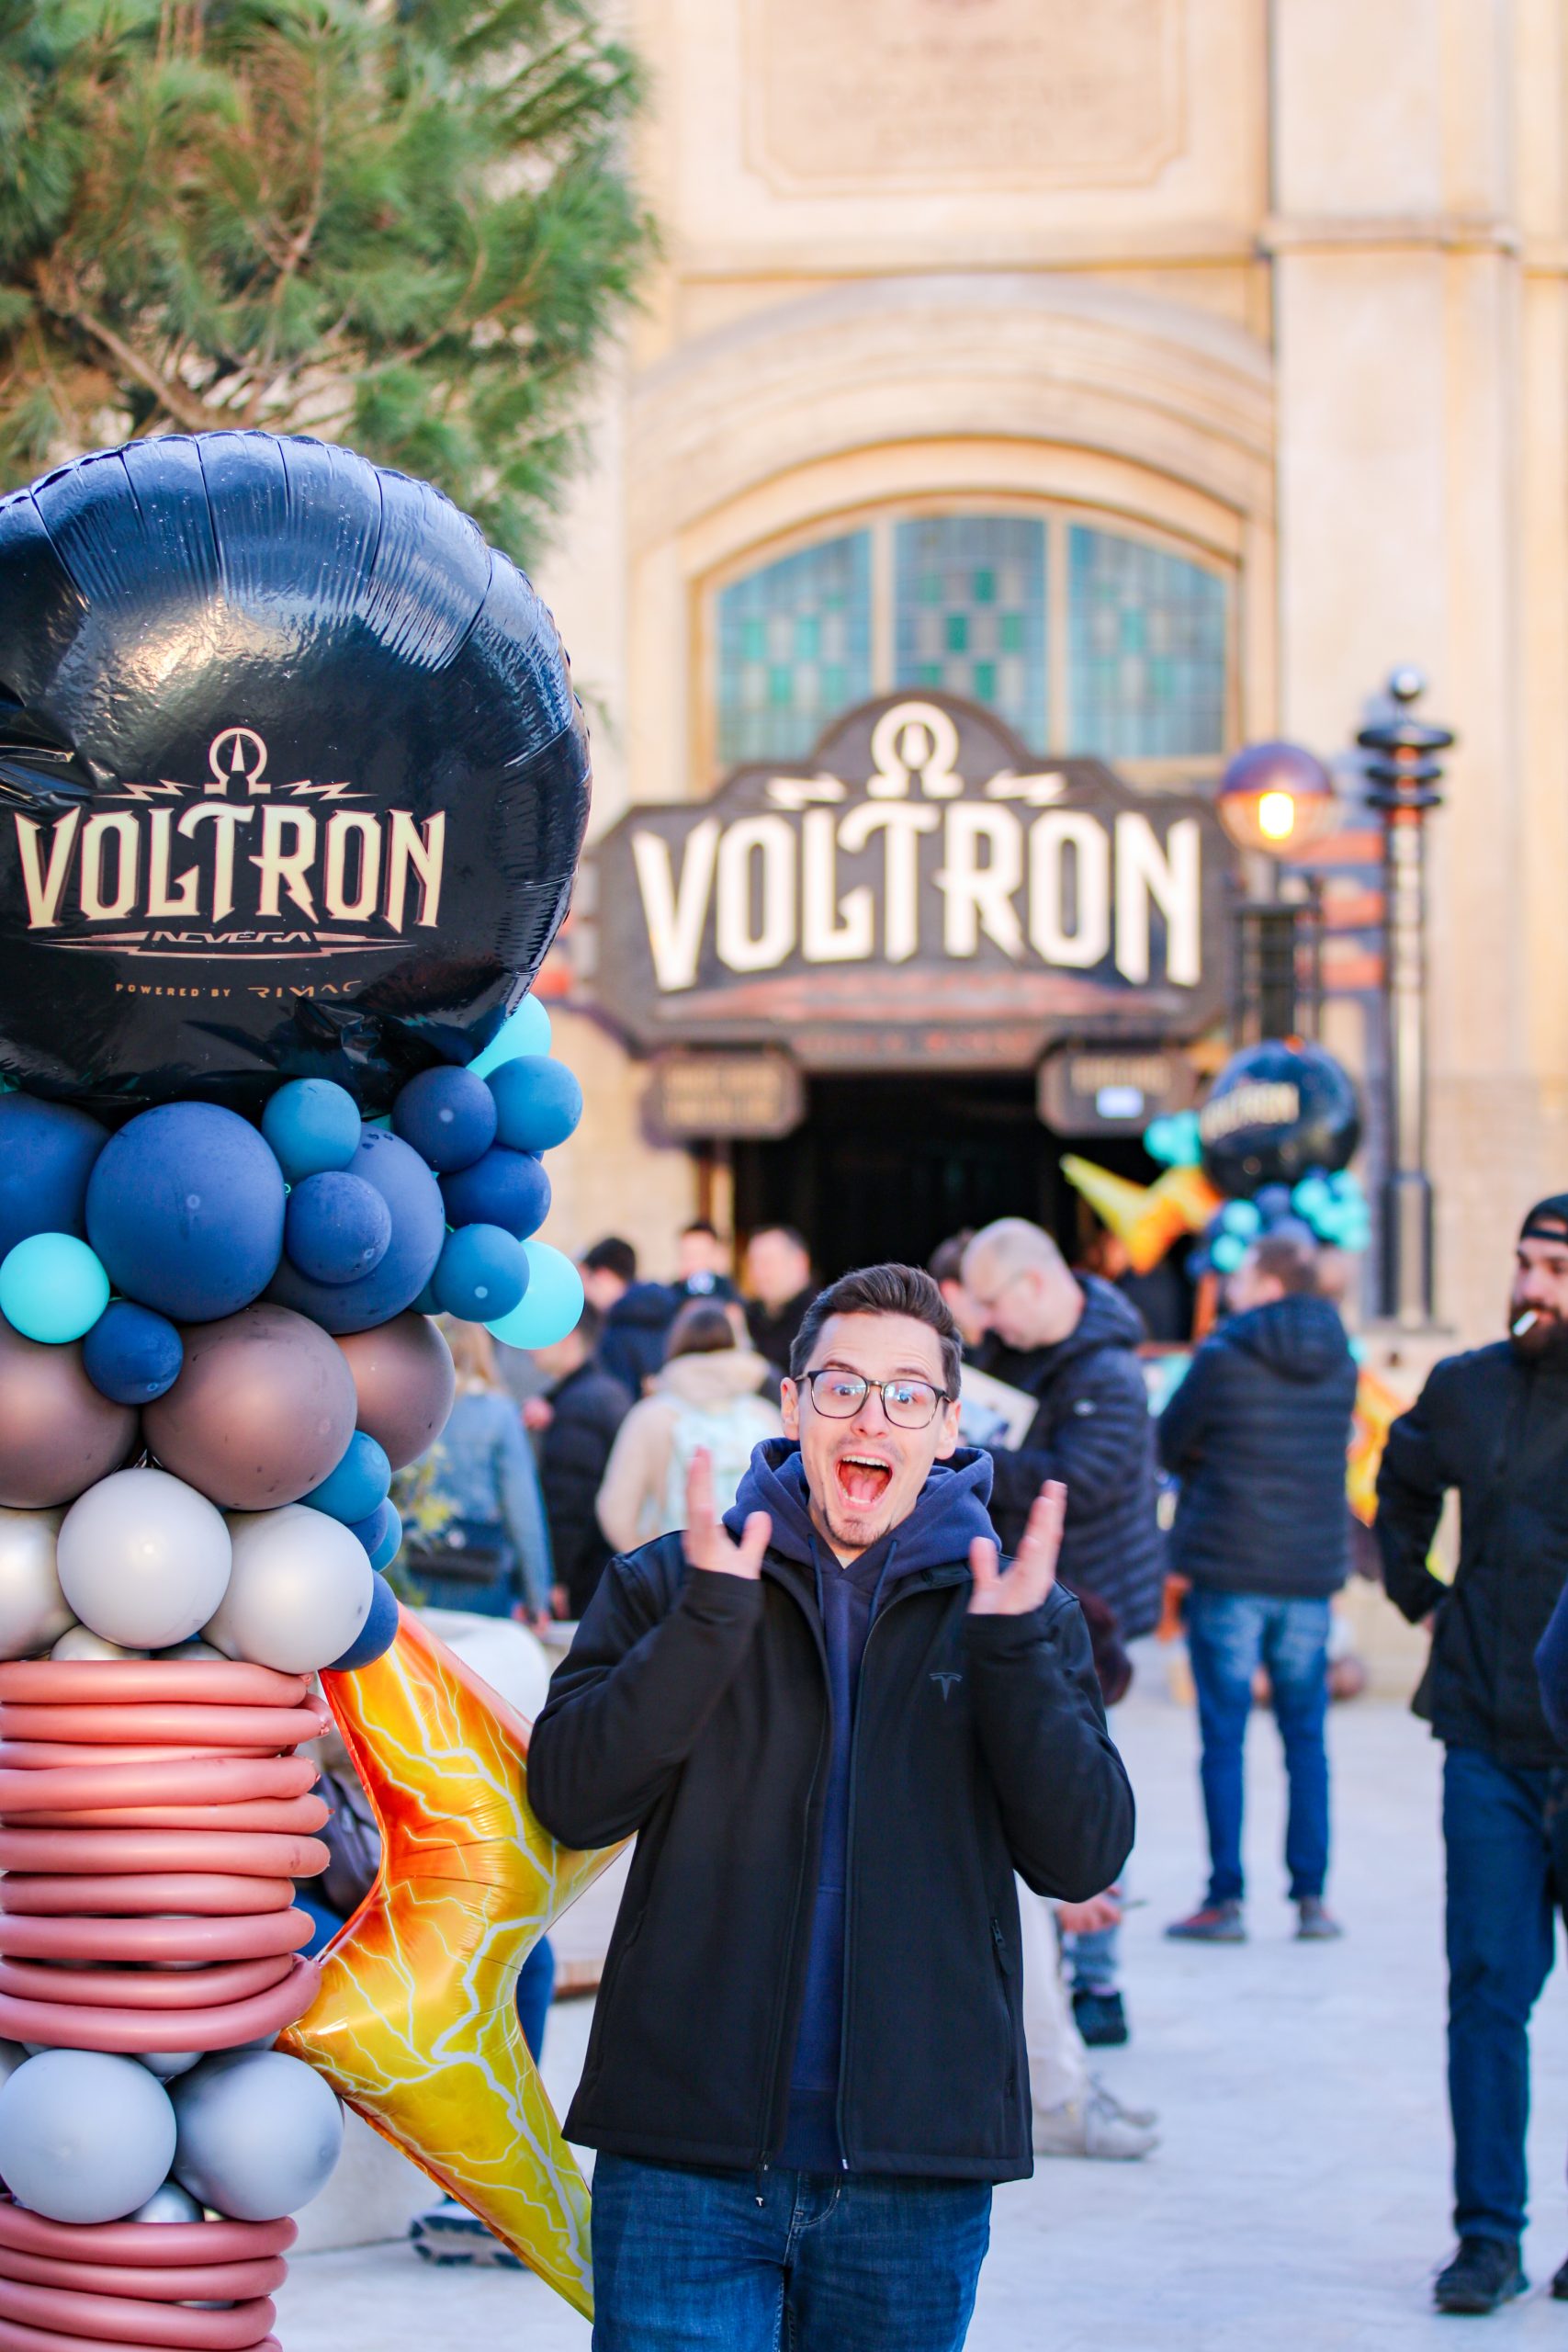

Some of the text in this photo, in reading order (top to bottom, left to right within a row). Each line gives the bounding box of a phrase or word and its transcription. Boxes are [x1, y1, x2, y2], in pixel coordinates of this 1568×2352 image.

[15, 801, 446, 933] VOLTRON
[632, 801, 1203, 990] VOLTRON
[116, 980, 362, 998] POWERED BY RIMAC
